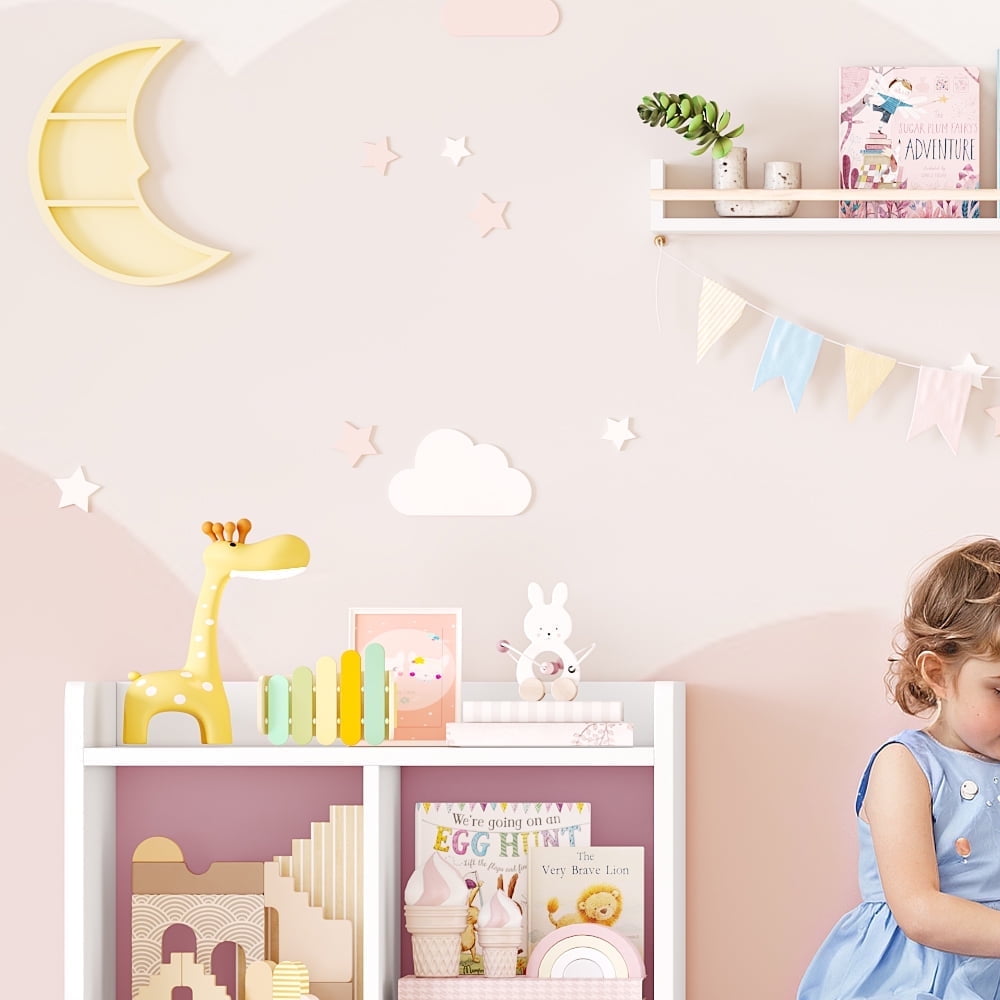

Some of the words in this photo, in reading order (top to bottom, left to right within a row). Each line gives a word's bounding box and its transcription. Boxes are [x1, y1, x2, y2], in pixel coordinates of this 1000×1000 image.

[904, 138, 976, 160] ADVENTURE
[452, 812, 485, 826] We're
[488, 814, 522, 831] going
[526, 815, 543, 826] on
[546, 814, 561, 825] an
[433, 825, 490, 857] EGG
[499, 825, 582, 857] HUNT
[576, 851, 595, 861] The
[542, 865, 566, 878] Very
[572, 865, 600, 875] Brave
[606, 865, 629, 875] Lion
